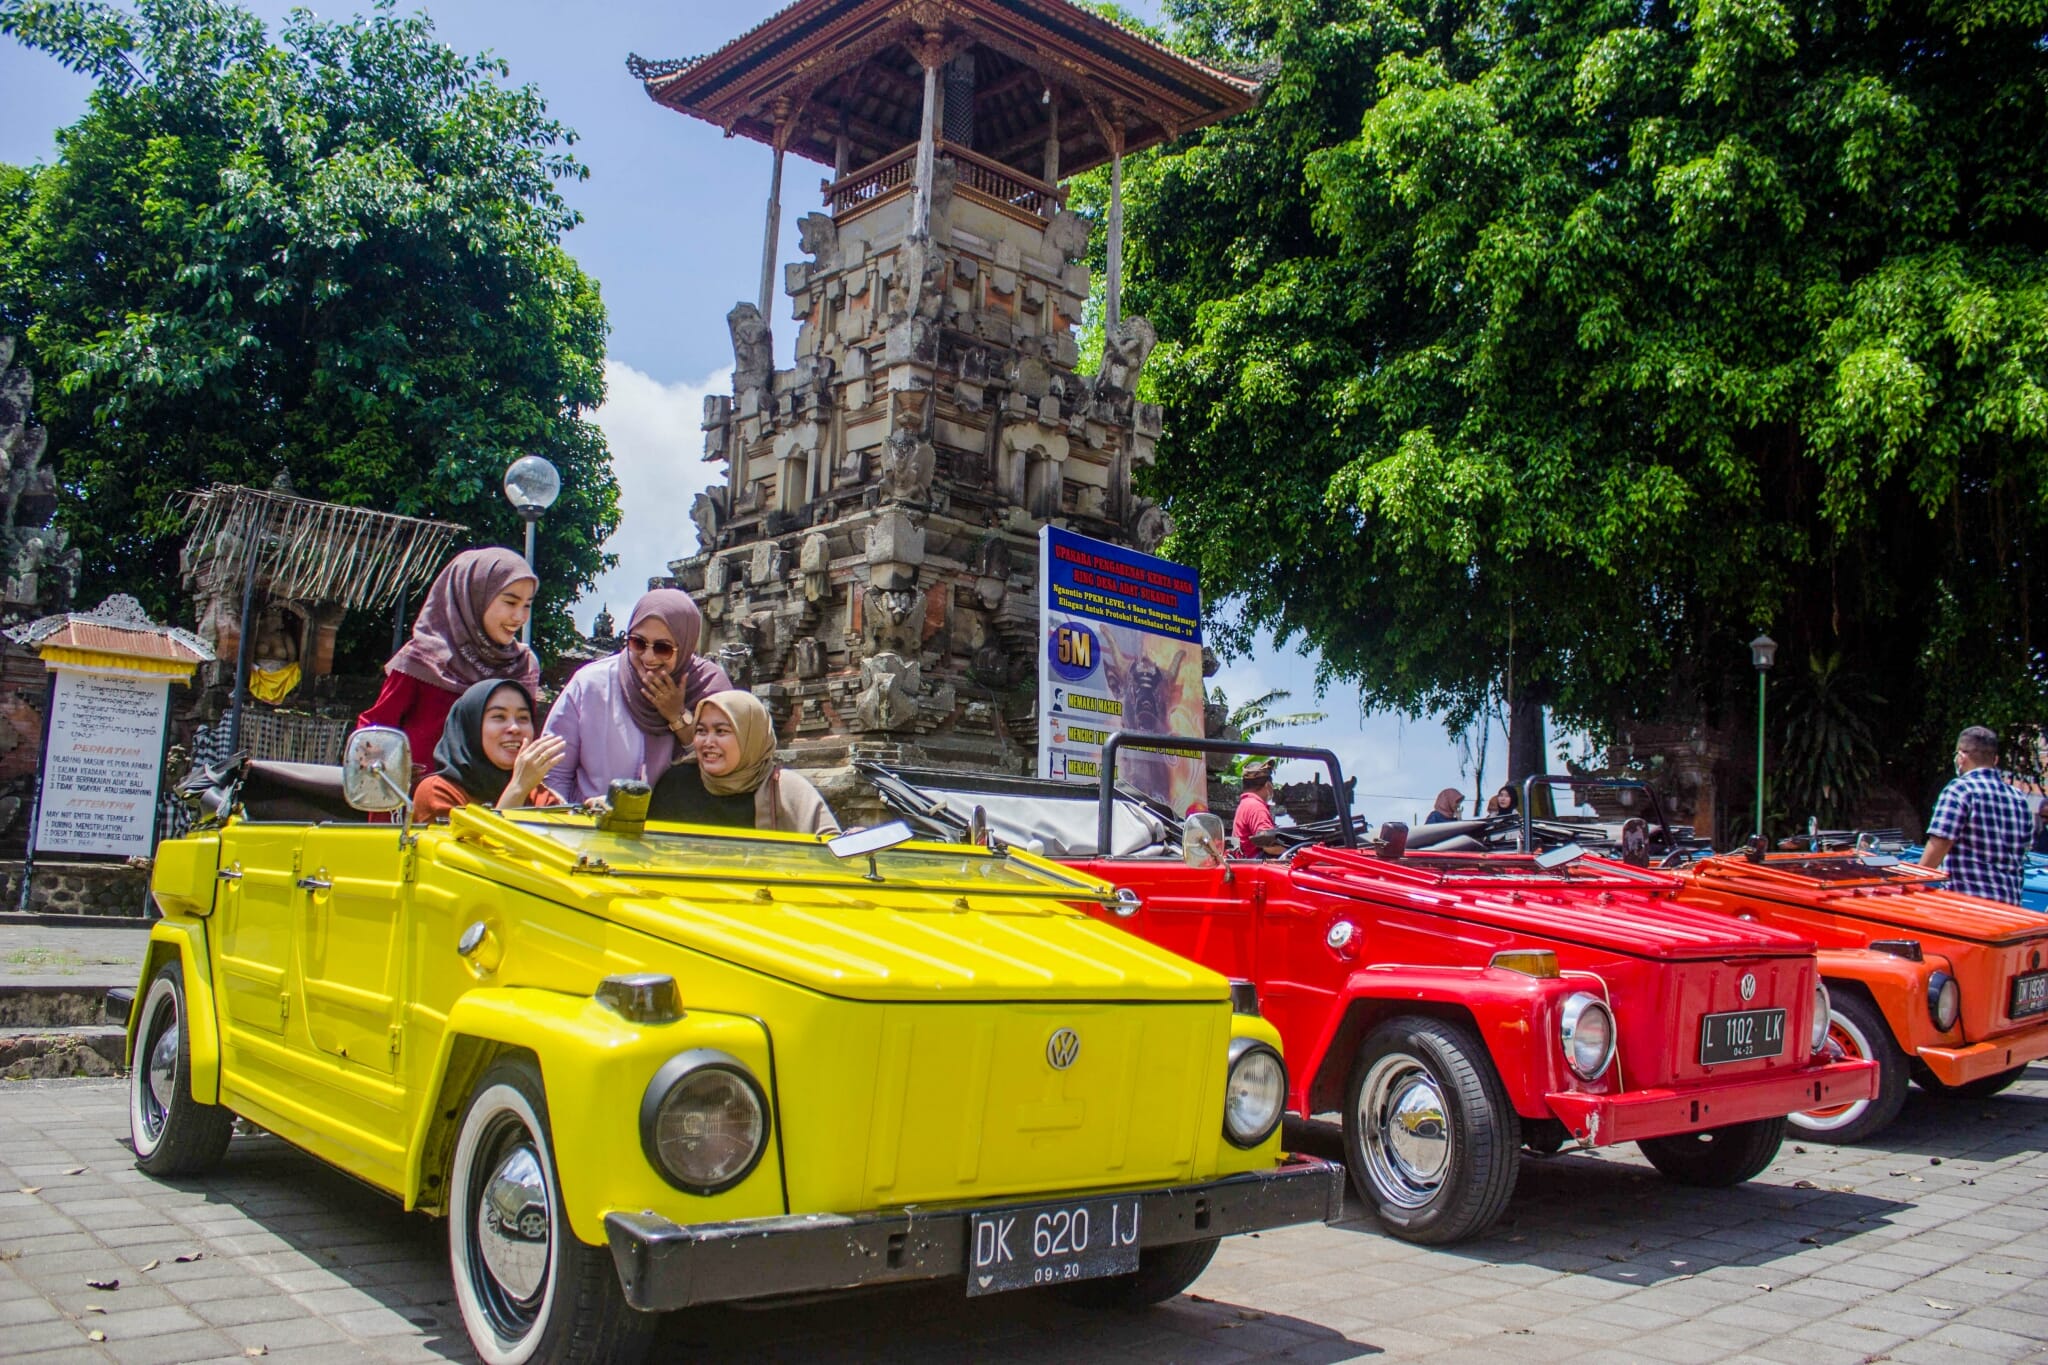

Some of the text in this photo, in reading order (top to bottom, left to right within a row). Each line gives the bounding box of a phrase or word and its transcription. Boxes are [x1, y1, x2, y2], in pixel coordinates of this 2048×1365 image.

[1096, 574, 1117, 592] DESA
[1118, 580, 1138, 598] ADAT
[1084, 591, 1104, 604] PPKM
[1105, 597, 1126, 610] LEVEL
[1106, 608, 1132, 622] Protokol
[1134, 615, 1164, 630] Kesehatan
[1164, 623, 1181, 634] Covid
[1186, 628, 1193, 637] 19
[1058, 628, 1091, 668] 5M
[1068, 692, 1122, 716] MEMAKAI MASKER
[1068, 726, 1094, 745] MENCUCI
[84, 758, 104, 766] MASUK
[131, 762, 152, 770] APABILA
[1068, 760, 1097, 777] MENJAGA
[76, 776, 111, 785] BERPAKAIAN
[112, 778, 127, 786] ADAT
[130, 780, 144, 788] BALI
[104, 786, 118, 794] ATAU
[66, 798, 136, 810] ATTENTION
[46, 810, 60, 818] MAY
[74, 812, 92, 820] ENTER
[106, 814, 128, 822] TEMPLE
[76, 822, 122, 832] MENSTRUATION
[122, 834, 144, 842] CUSTOM
[1741, 973, 1756, 1001] VW
[1706, 1014, 1782, 1048] L 1102 LK
[1047, 1027, 1080, 1070] VW
[976, 1202, 1138, 1267] DK 620 IJ
